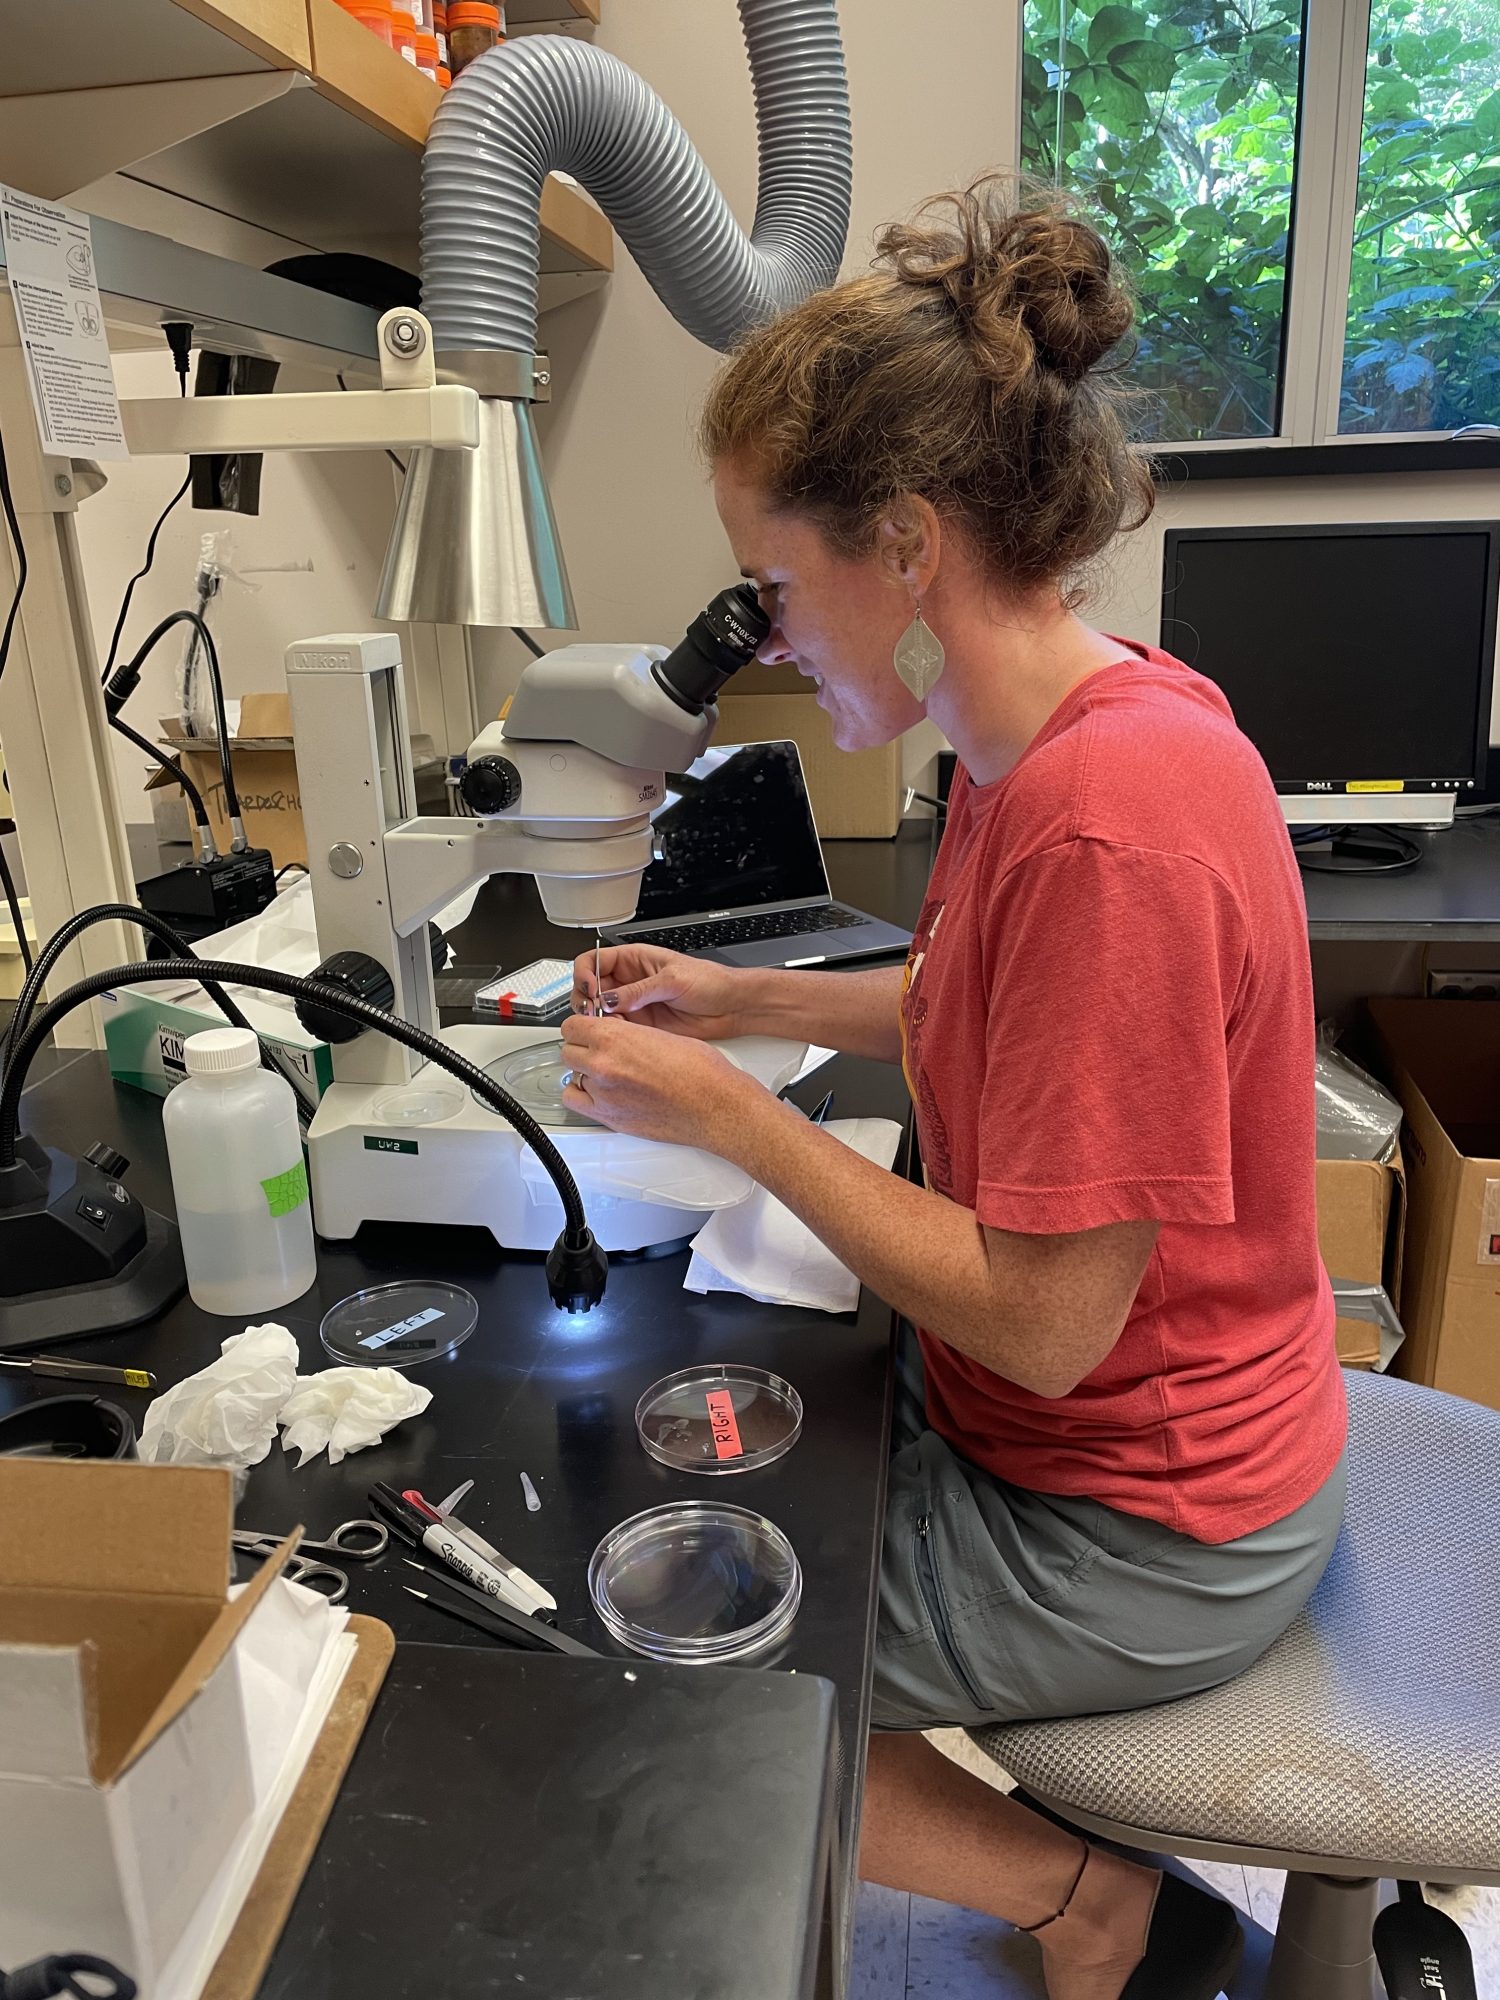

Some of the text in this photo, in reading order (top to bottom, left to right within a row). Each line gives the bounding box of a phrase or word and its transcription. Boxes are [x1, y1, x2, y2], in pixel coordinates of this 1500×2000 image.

[727, 631, 744, 647] Nikon
[298, 652, 349, 668] Nikon
[1306, 782, 1333, 791] DELL
[378, 1140, 400, 1151] UW2
[375, 1313, 426, 1342] LEFT
[710, 1403, 734, 1443] RIGHT
